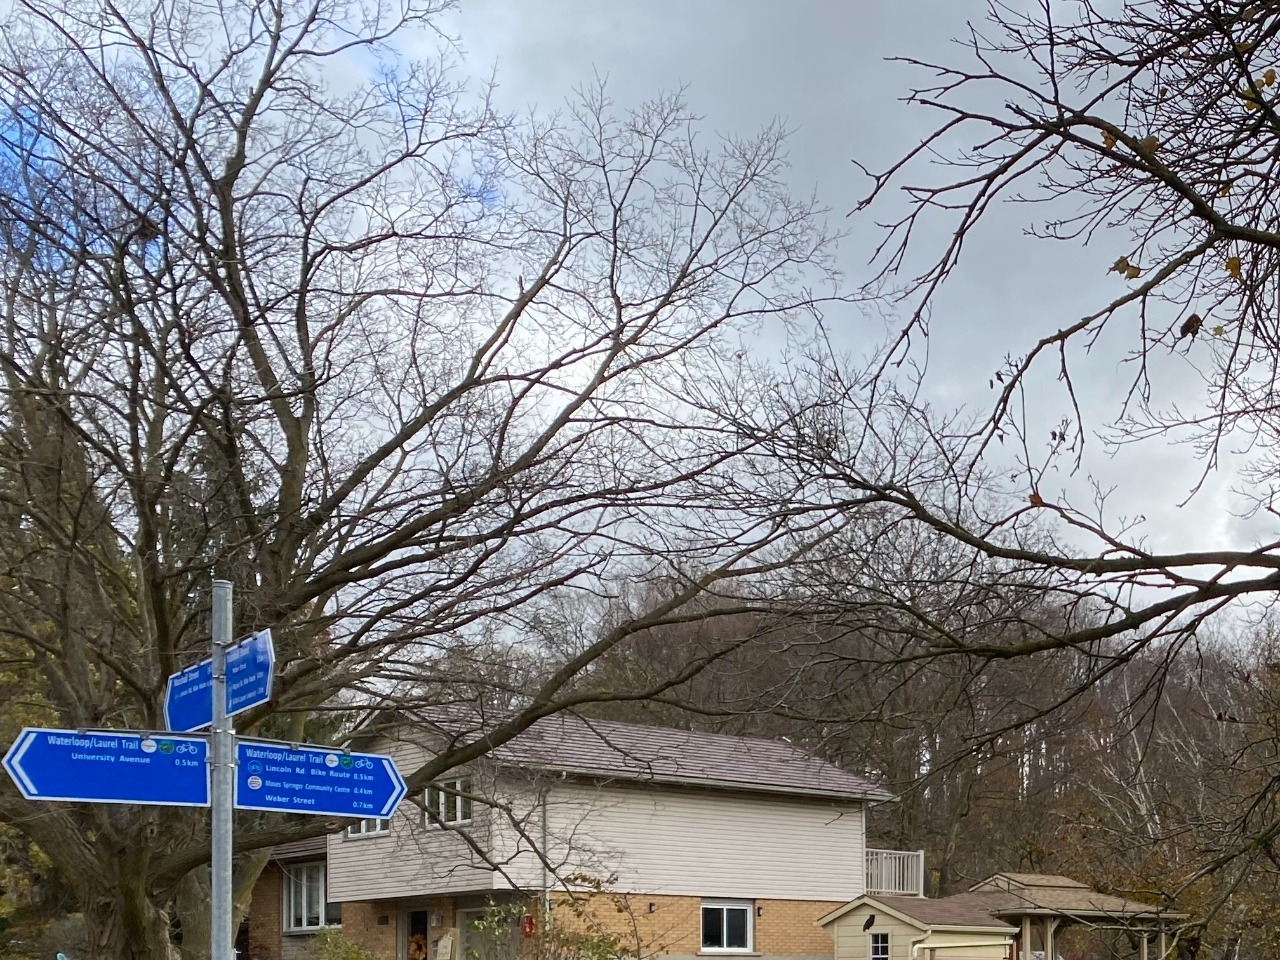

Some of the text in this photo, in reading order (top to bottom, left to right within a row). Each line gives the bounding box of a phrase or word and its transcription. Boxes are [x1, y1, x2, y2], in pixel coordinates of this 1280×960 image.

[121, 739, 138, 749] Trail
[71, 752, 150, 763] University Avenue
[309, 754, 324, 764] Trail
[265, 765, 292, 773] Lincoln
[330, 771, 350, 779] Route
[265, 780, 281, 788] Moses
[305, 784, 332, 793] Community
[265, 794, 289, 803] Weber
[293, 796, 315, 805] Street
